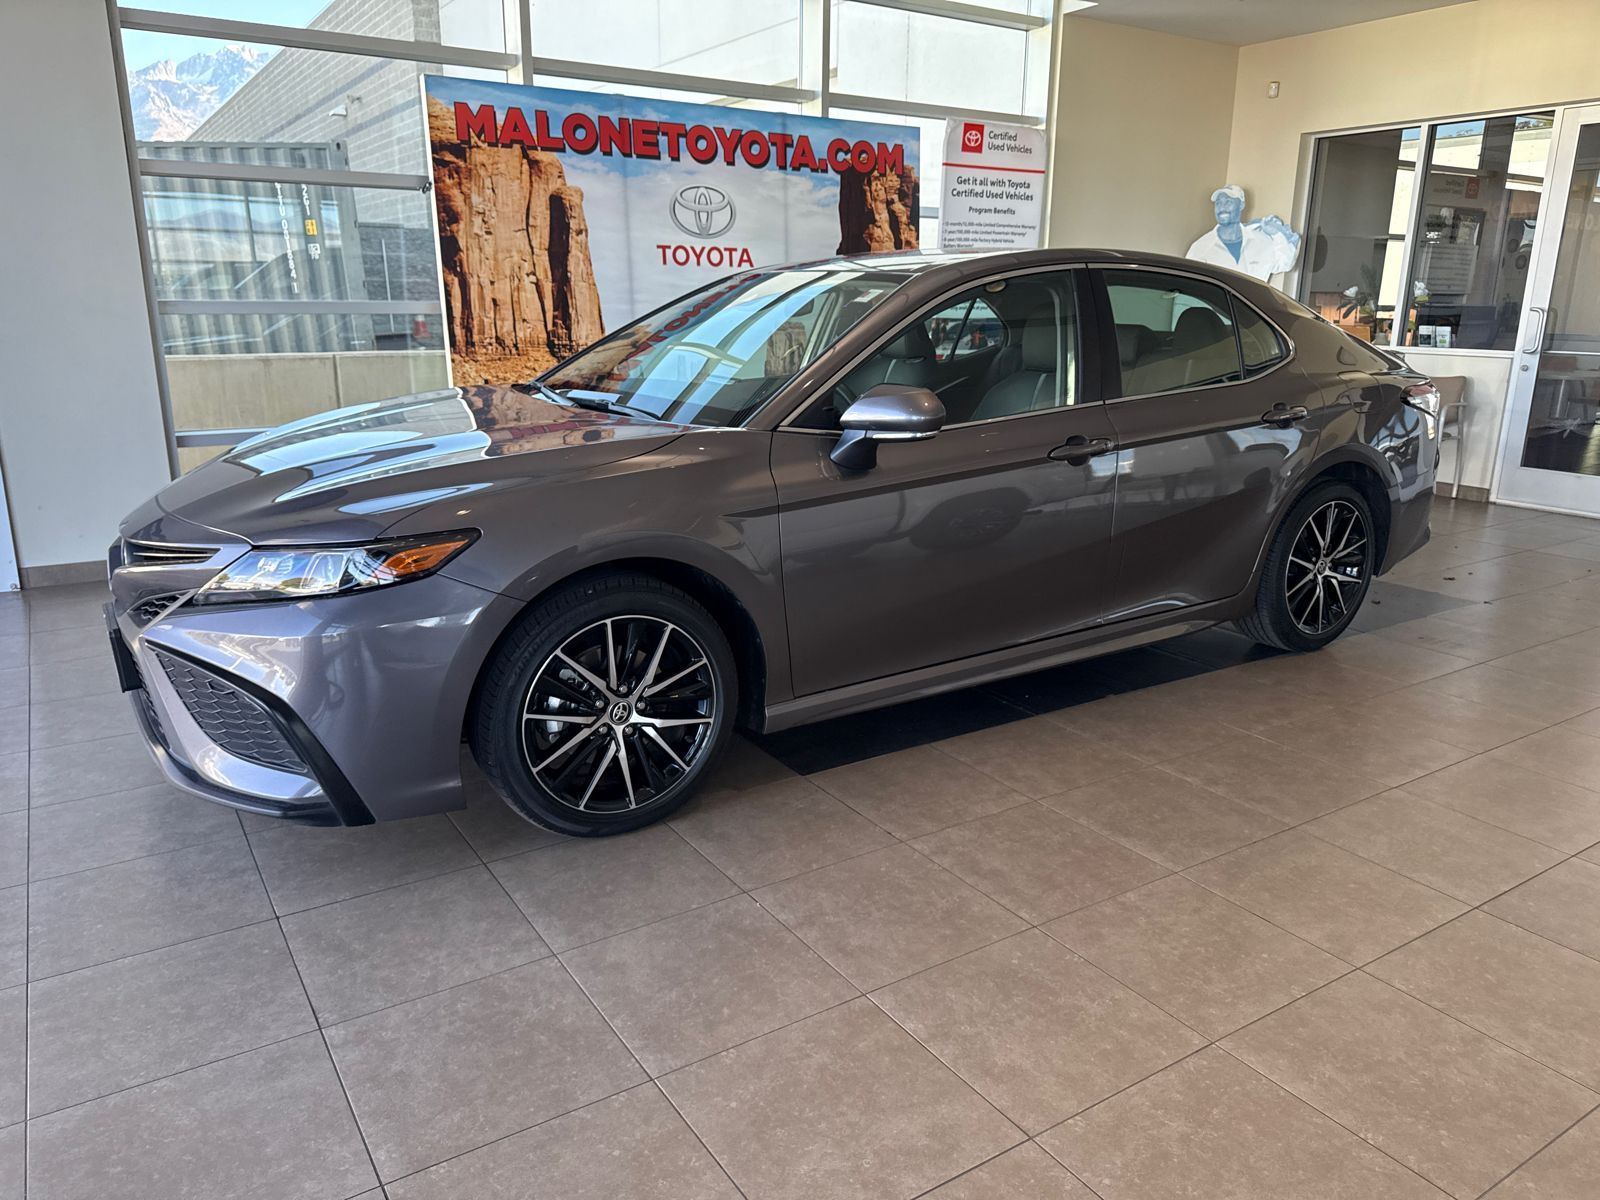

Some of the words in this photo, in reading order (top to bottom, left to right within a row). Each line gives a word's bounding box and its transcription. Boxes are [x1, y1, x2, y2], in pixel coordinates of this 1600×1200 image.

[453, 100, 905, 175] MALONETOYOTA.COM
[988, 130, 1018, 142] Certified
[987, 142, 1005, 152] Used
[1006, 143, 1033, 155] Vehicles
[956, 175, 971, 185] Get
[971, 176, 979, 186] it
[979, 176, 989, 187] all
[989, 178, 1007, 188] with
[1007, 179, 1031, 190] Toyota
[951, 188, 984, 199] Certified
[985, 190, 1004, 200] Used
[1005, 191, 1034, 201] Vehicles
[968, 206, 993, 215] Program
[993, 207, 1016, 215] Benefits
[656, 244, 754, 268] TOYOTA
